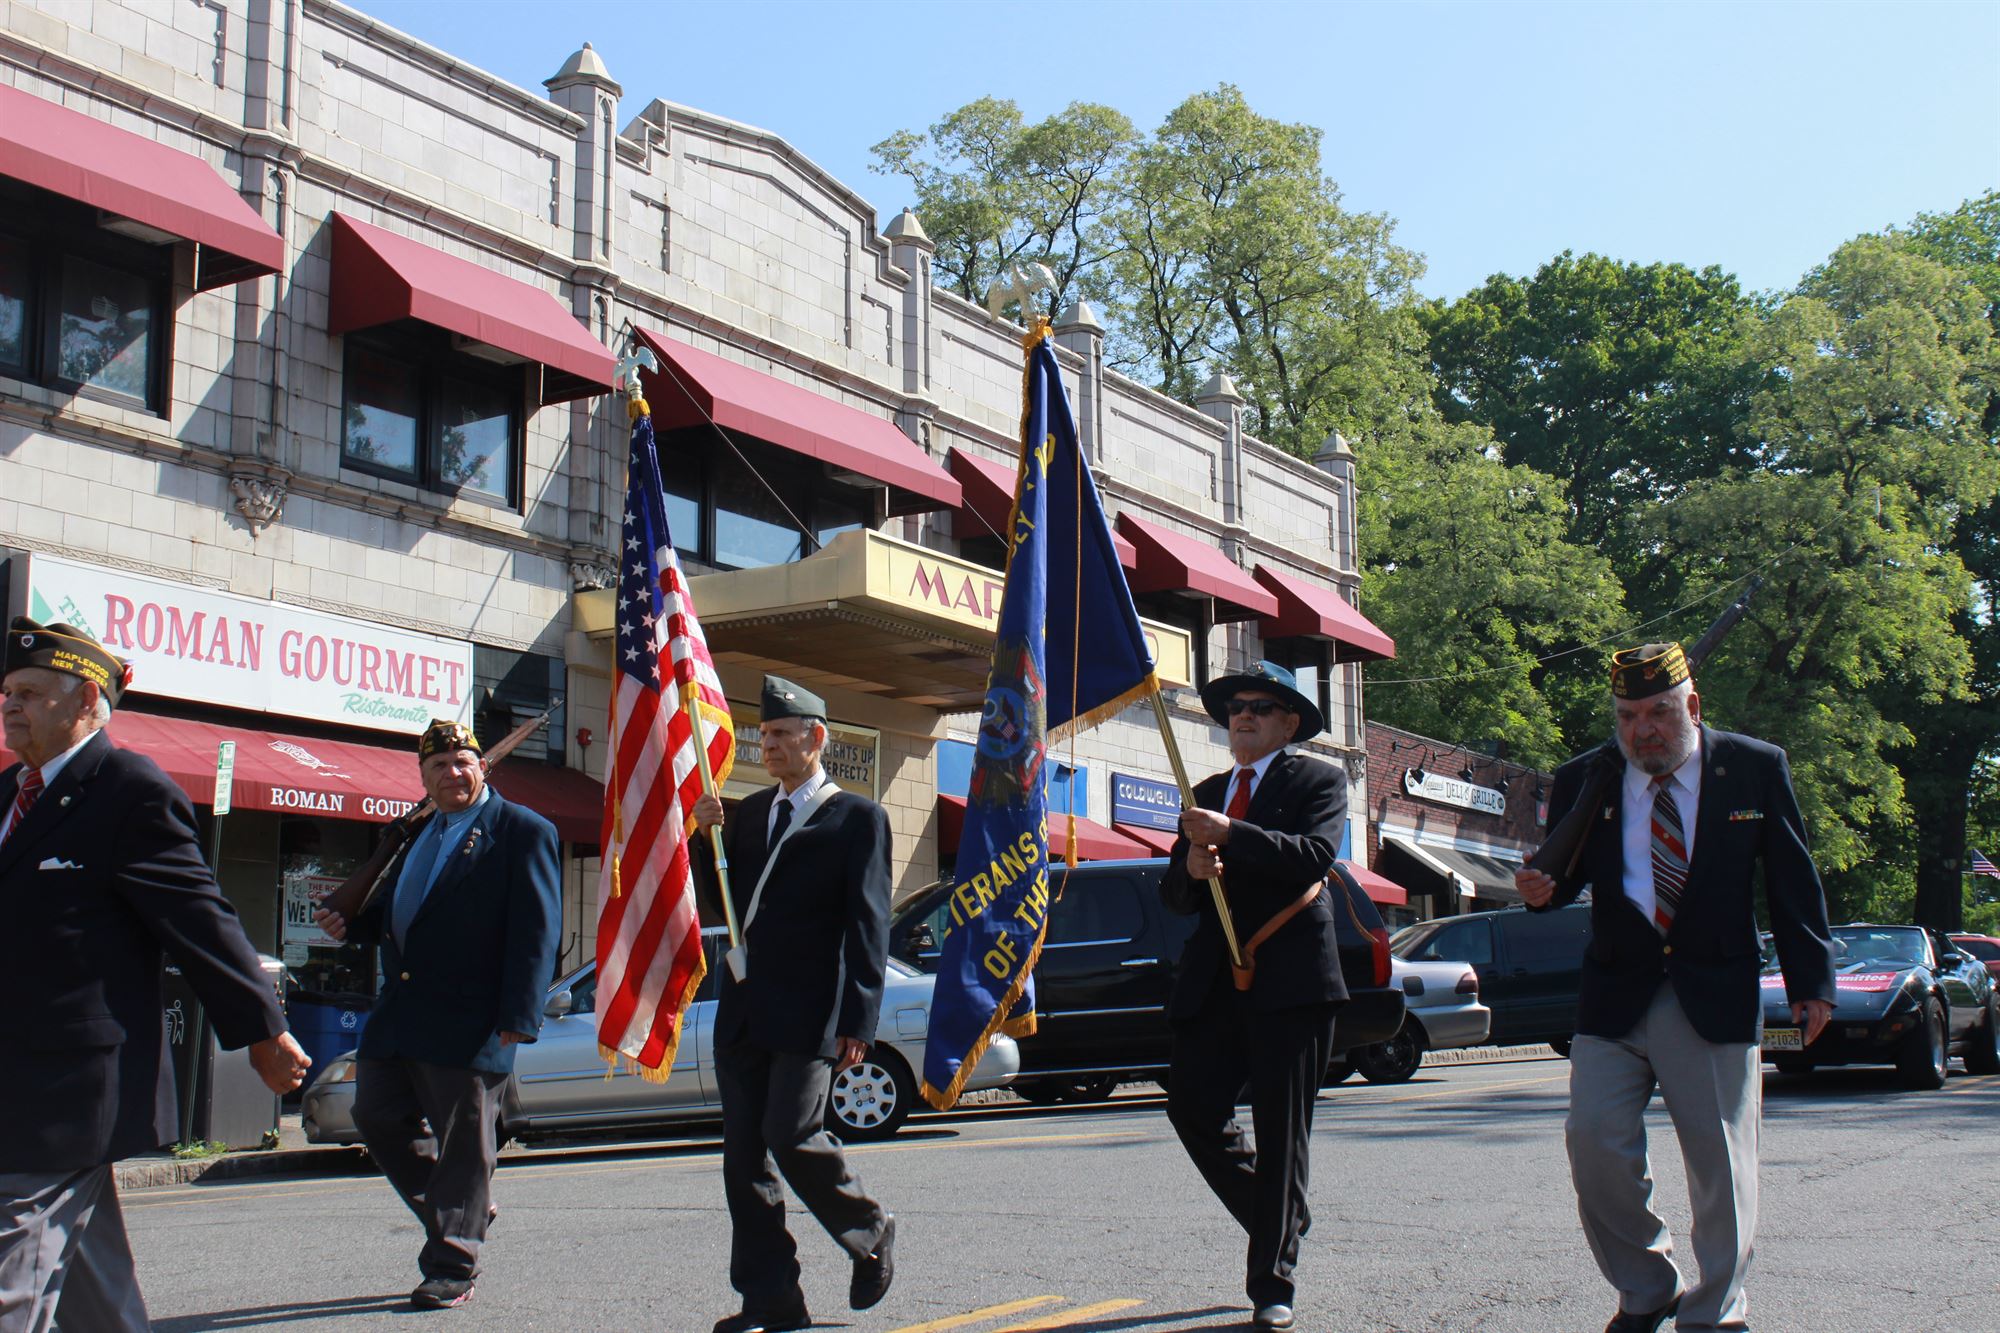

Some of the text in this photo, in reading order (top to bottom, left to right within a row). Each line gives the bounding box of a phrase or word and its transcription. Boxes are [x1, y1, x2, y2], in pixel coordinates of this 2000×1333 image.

[51, 658, 74, 670] NEW
[102, 593, 465, 706] ROMAN GOURMET
[54, 650, 110, 679] MAPLEWOOD
[340, 692, 429, 724] Ristorante
[861, 749, 874, 764] UP
[270, 787, 418, 818] ROMAN GOUR
[1446, 782, 1463, 799] DELI
[1471, 788, 1497, 809] GRILLE
[308, 882, 325, 891] THE
[943, 831, 1039, 940] TERANS
[983, 869, 1049, 979] OF THE
[1776, 1033, 1800, 1047] 1026
